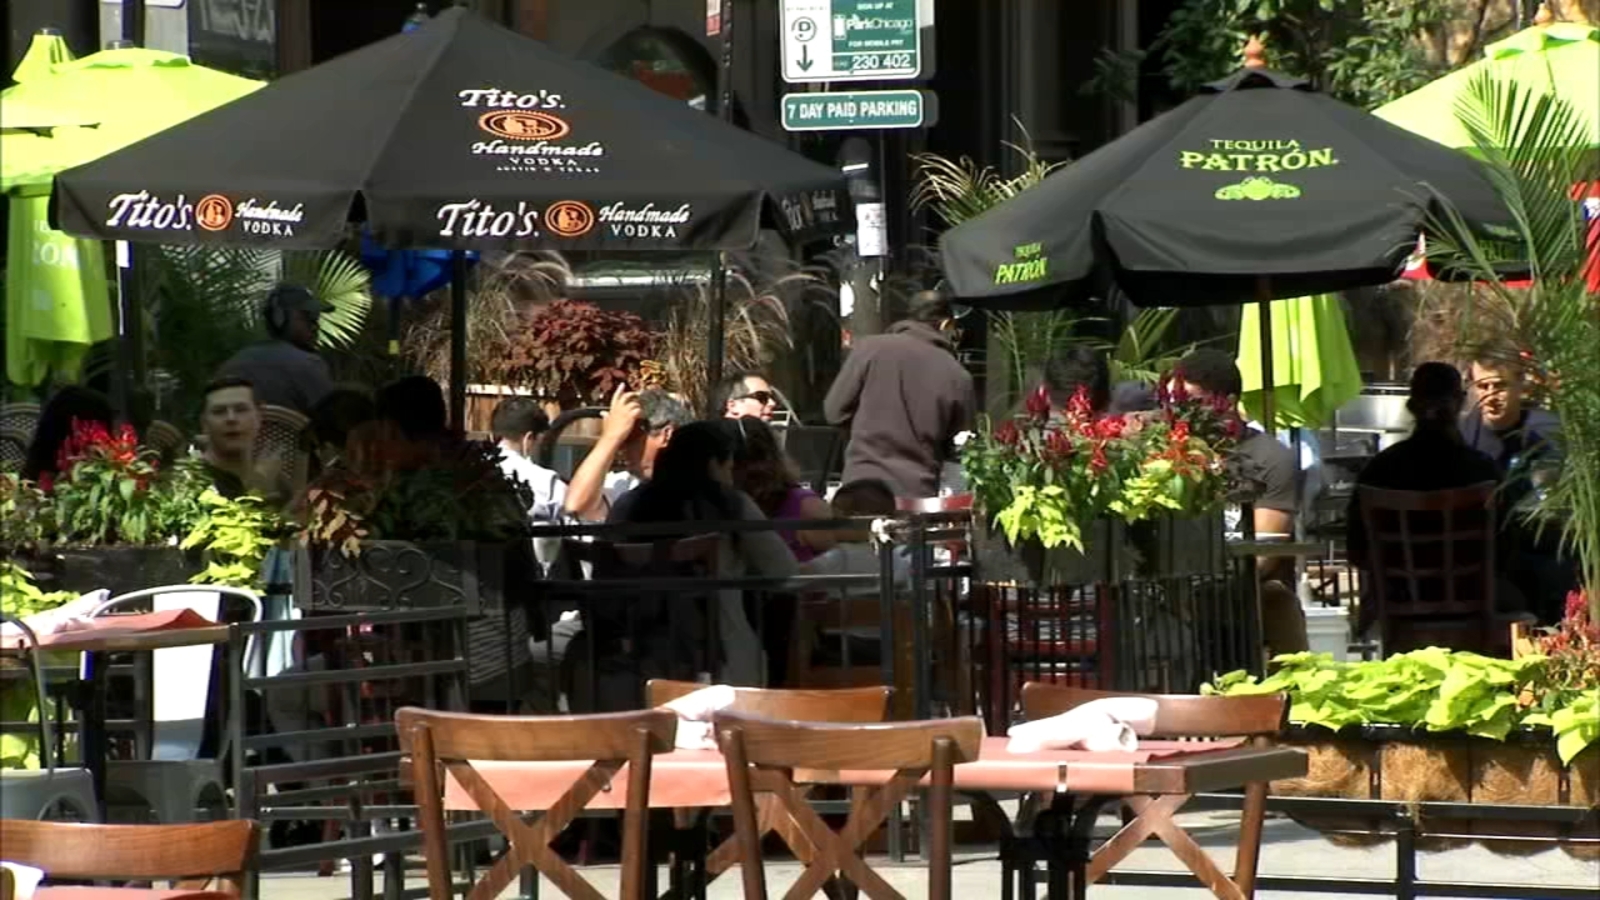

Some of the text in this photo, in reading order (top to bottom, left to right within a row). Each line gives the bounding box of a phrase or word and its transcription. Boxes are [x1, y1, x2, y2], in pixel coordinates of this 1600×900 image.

[852, 55, 880, 70] 230
[883, 53, 911, 68] 402
[787, 100, 917, 119] 7 DAY PAID PARKING
[471, 140, 604, 157] Handmade
[1210, 139, 1300, 151] TEQUILA
[509, 157, 579, 166] VODKA
[233, 198, 304, 222] Handmade
[598, 202, 690, 223] Handmade
[243, 221, 294, 237] VODKA
[610, 224, 677, 238] VODKA
